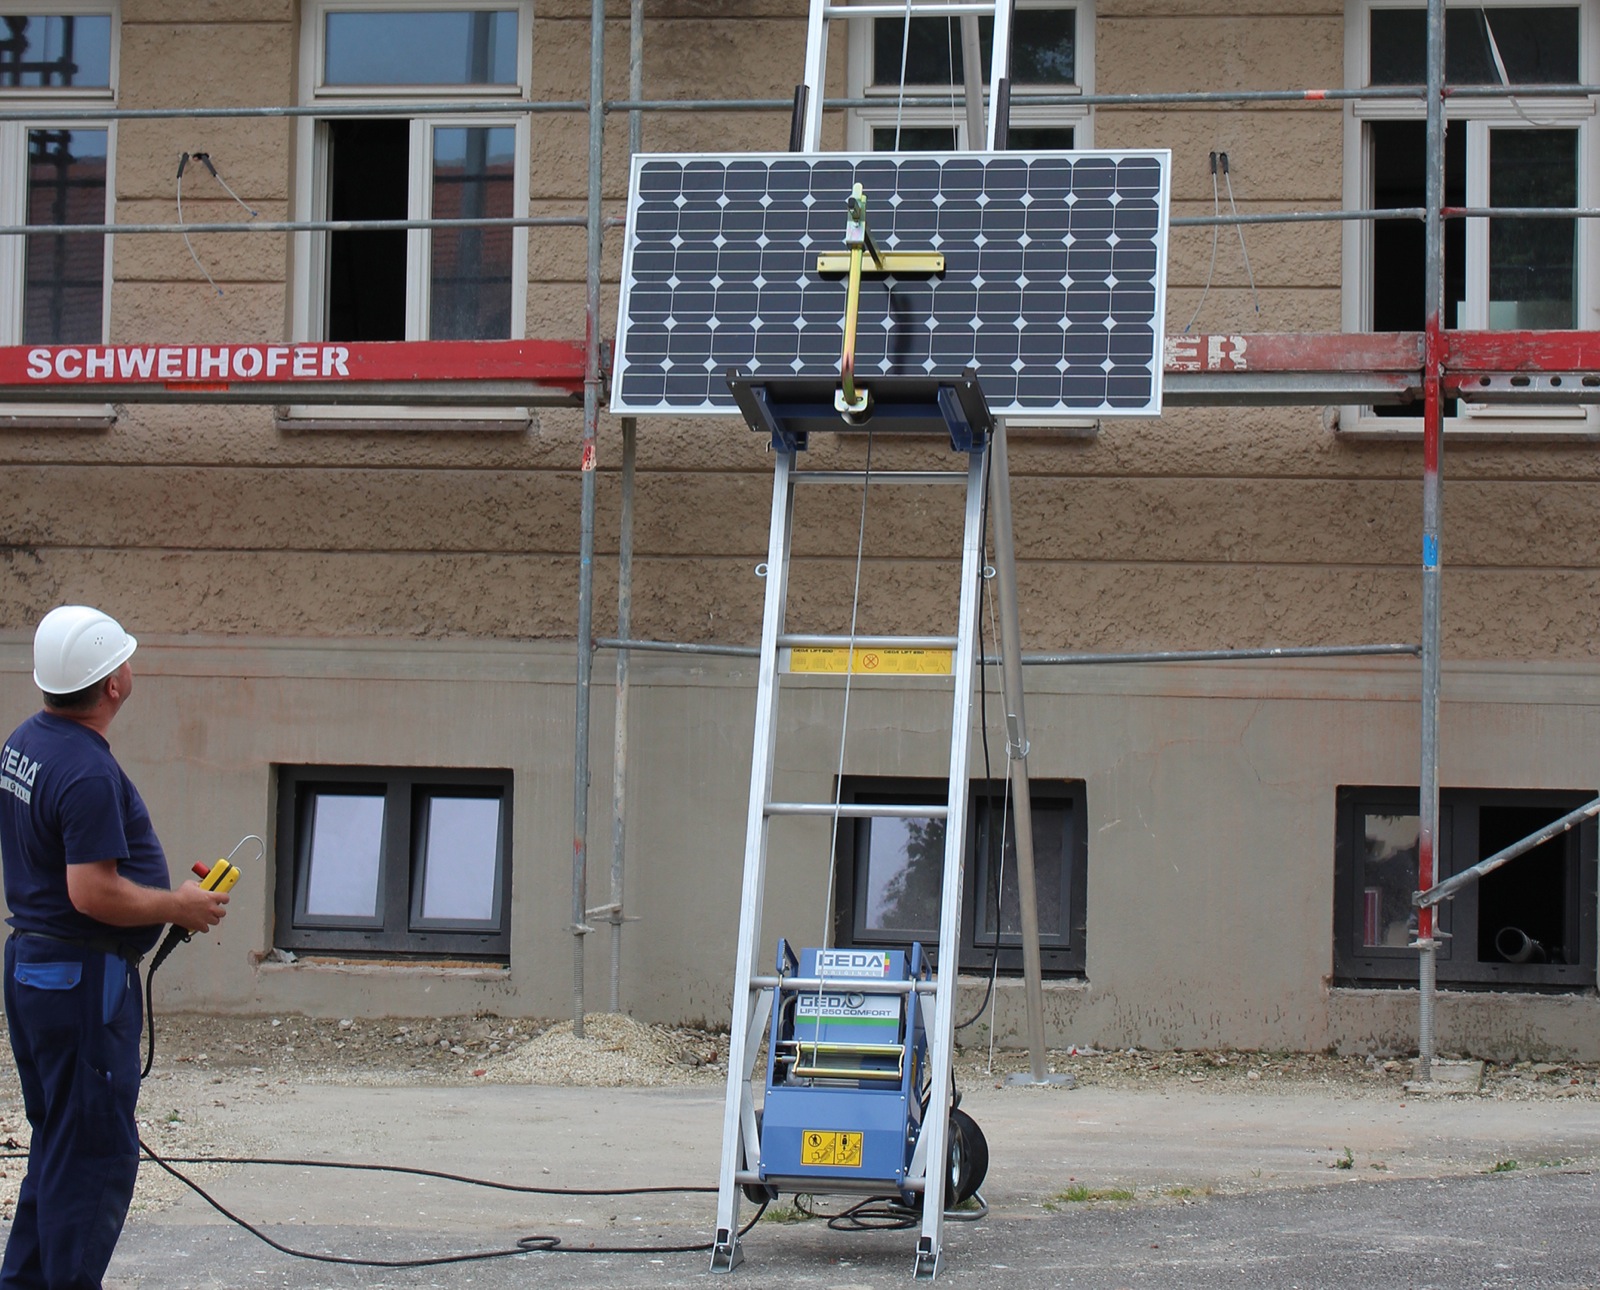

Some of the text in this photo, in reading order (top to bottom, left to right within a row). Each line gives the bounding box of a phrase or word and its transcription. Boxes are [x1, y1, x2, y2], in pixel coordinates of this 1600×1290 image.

[26, 346, 350, 379] SCHWEIHOFER
[818, 954, 883, 968] GEDA
[822, 969, 877, 977] ORIGINAL
[843, 1008, 892, 1017] COMFORT
